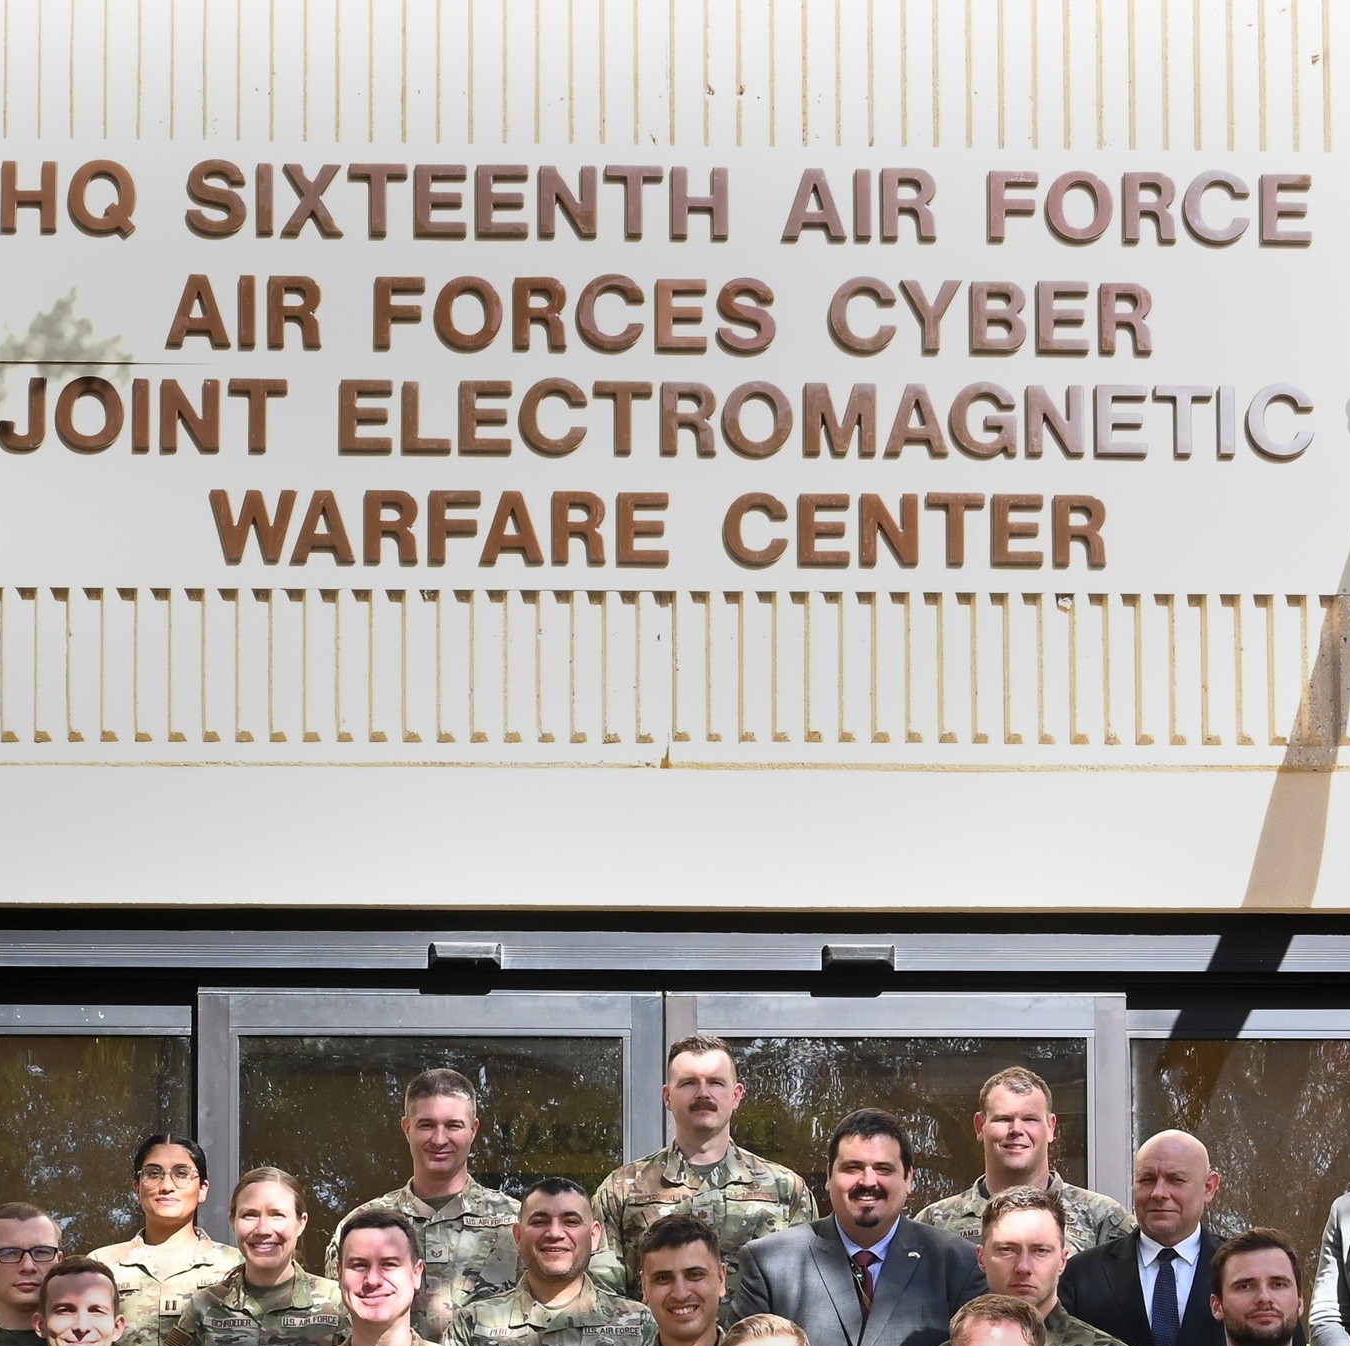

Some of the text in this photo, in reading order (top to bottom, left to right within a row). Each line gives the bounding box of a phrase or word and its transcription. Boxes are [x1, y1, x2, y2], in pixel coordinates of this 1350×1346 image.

[184, 159, 728, 243] SIXTEENTH
[780, 168, 936, 244] AIR
[985, 171, 1312, 248] FORCE
[164, 273, 1153, 357] AIR FORCES CYBER
[337, 378, 1315, 461] ELECTROMAGNETIC
[208, 489, 1107, 570] WARFARE CENTER
[211, 1318, 251, 1328] SCHROEDER
[282, 1315, 337, 1327] U.S. AIR FORCE
[584, 1327, 640, 1335] U.S. AIR FORCE
